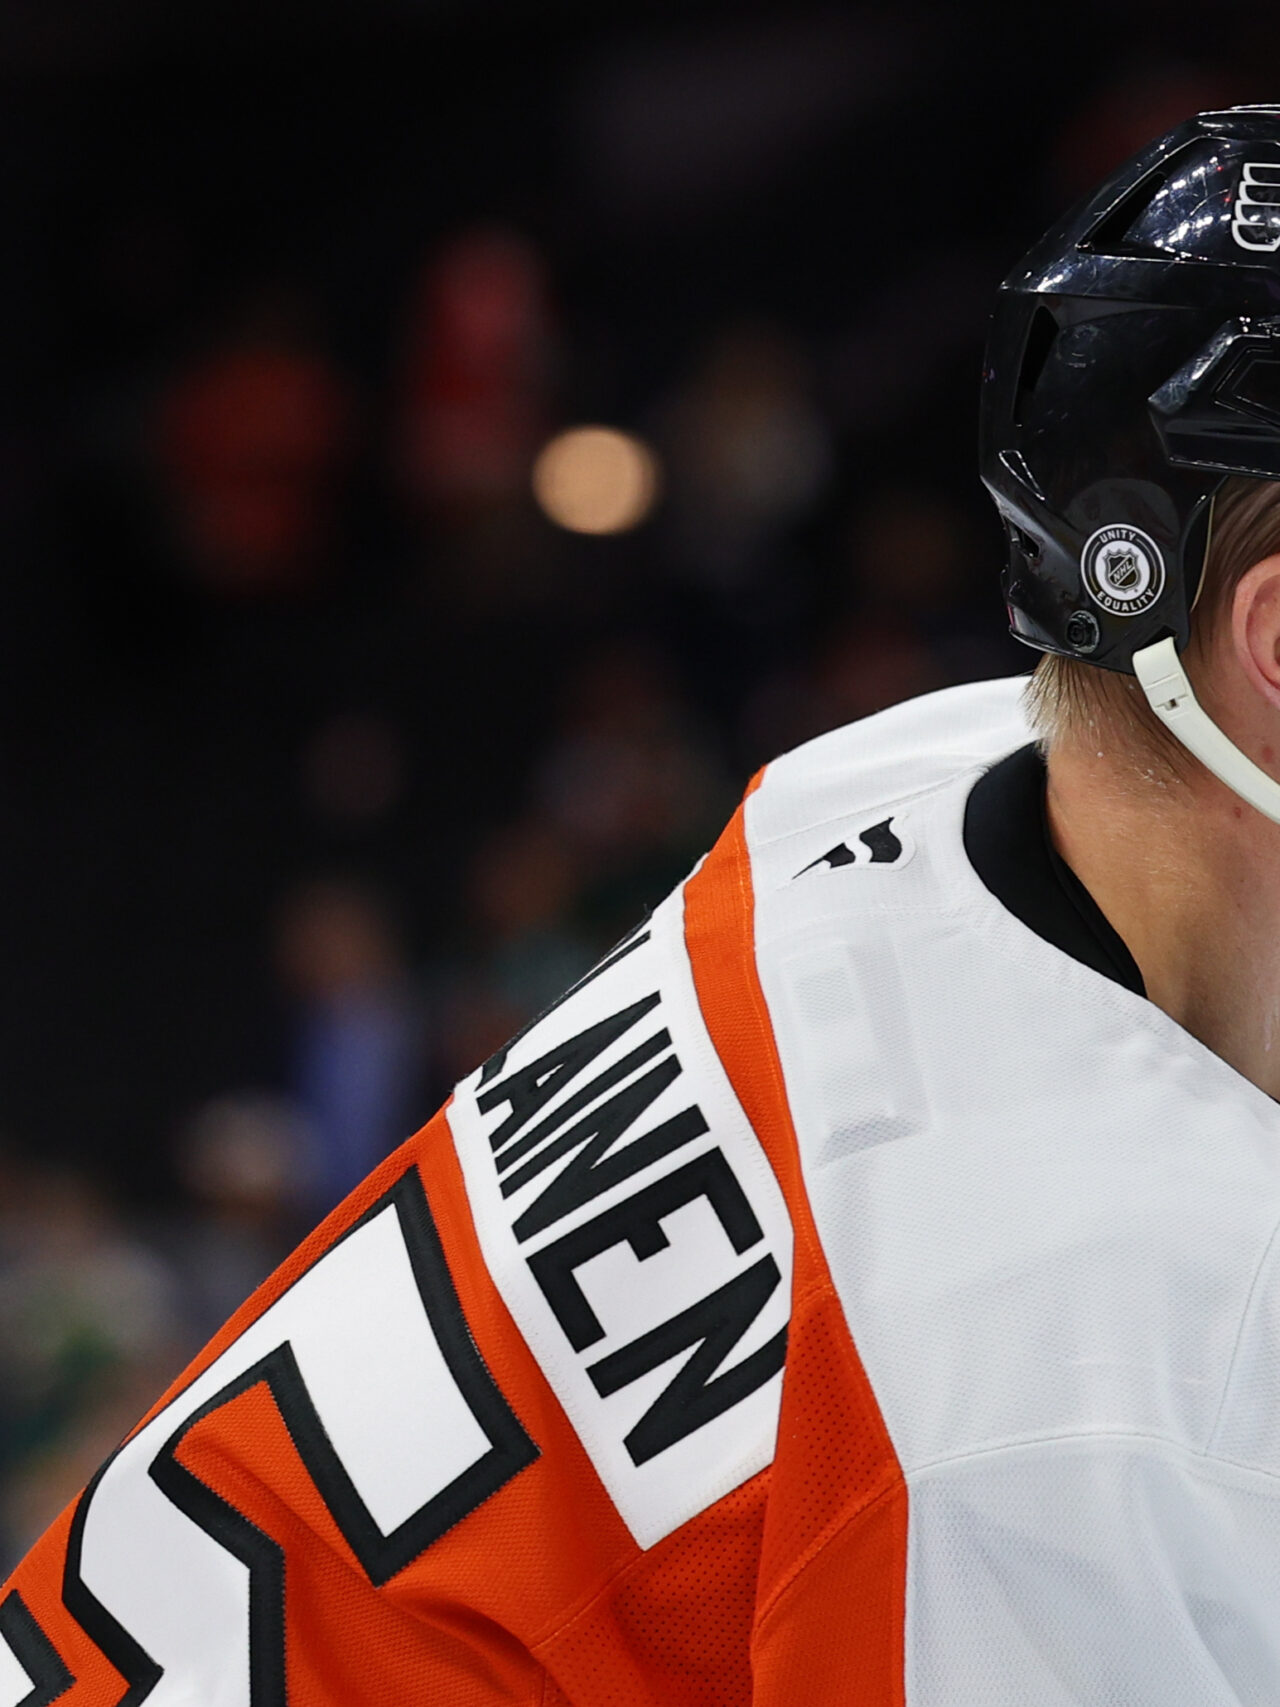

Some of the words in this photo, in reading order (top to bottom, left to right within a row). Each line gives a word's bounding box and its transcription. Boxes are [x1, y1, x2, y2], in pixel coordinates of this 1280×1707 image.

[1099, 529, 1136, 543] UNITY
[1112, 560, 1132, 582] NHL
[1097, 589, 1155, 611] EQUALITY
